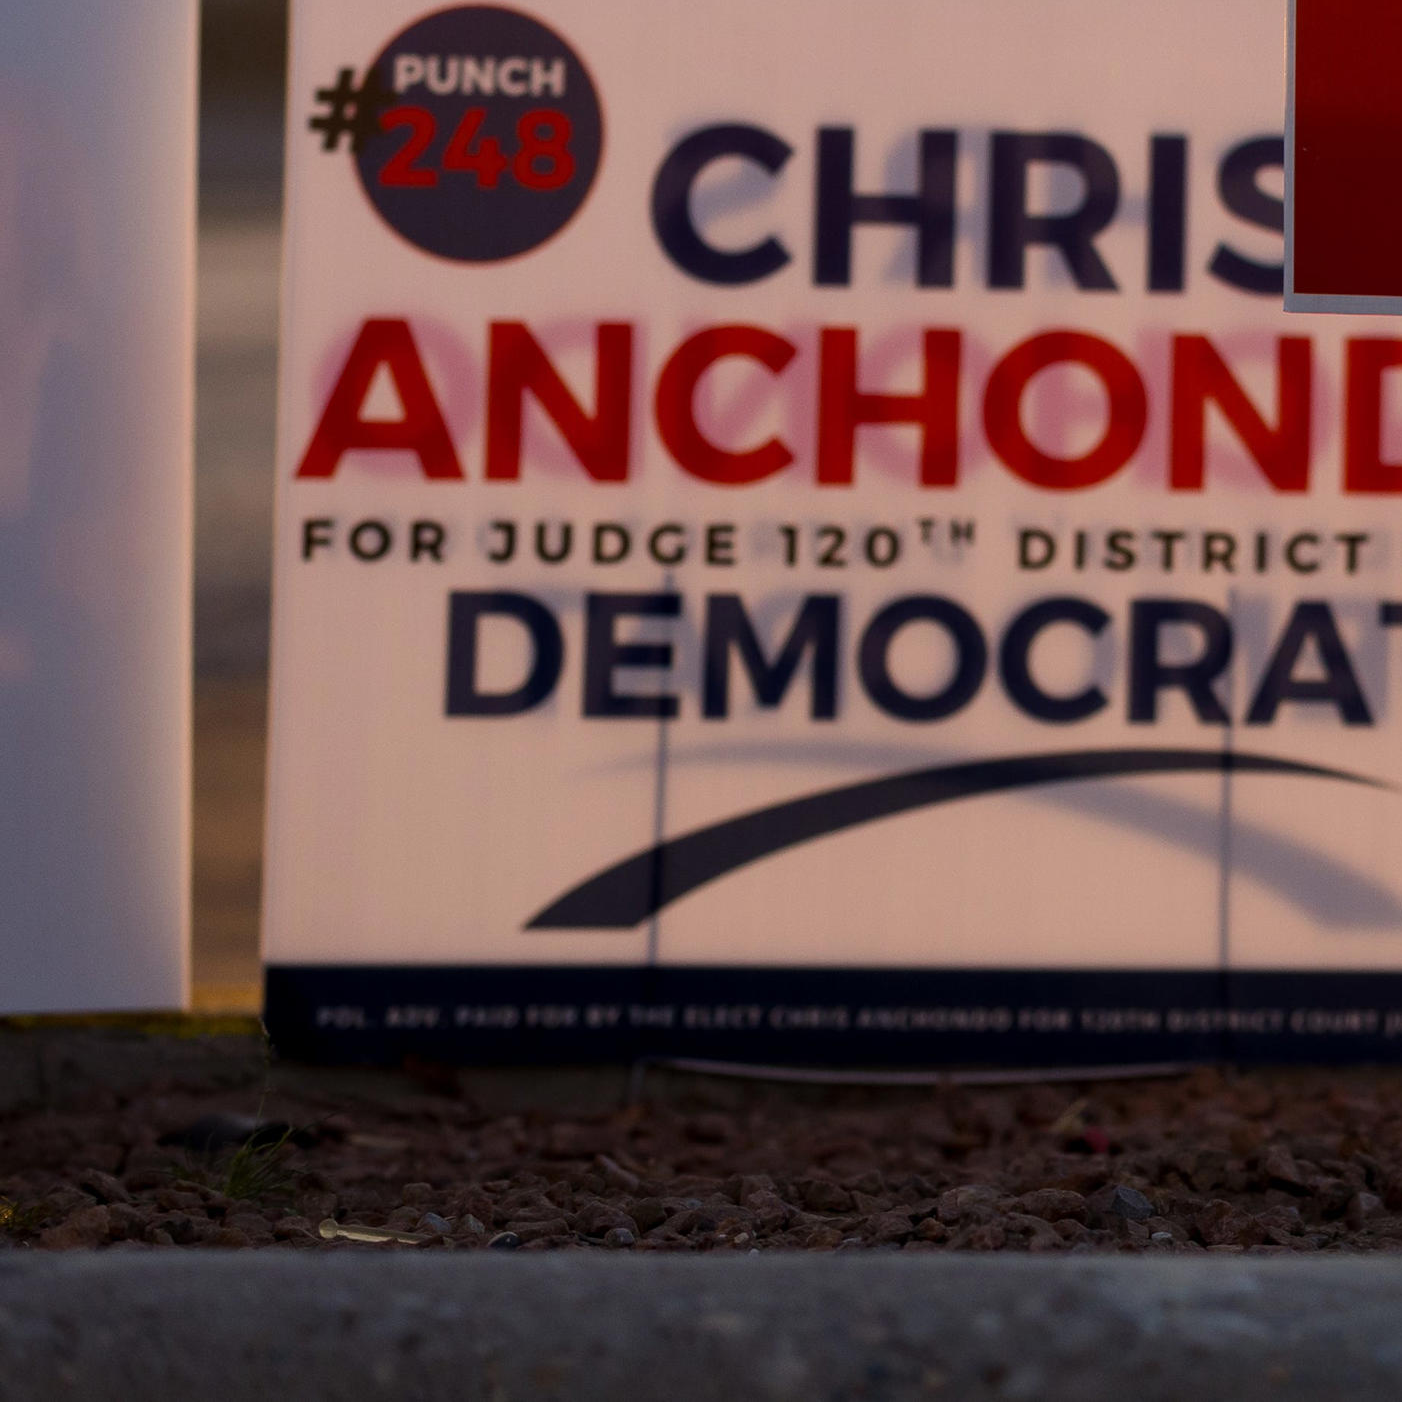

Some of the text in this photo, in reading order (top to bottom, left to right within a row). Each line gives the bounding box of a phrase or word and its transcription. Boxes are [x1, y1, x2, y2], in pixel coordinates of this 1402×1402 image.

[394, 55, 565, 96] PUNCH
[650, 123, 1285, 296] CHRIS
[300, 517, 448, 564] FOR
[490, 520, 738, 567] JUDGE
[780, 517, 976, 569] 120TH
[1017, 528, 1369, 575] DISTRICT
[455, 1005, 519, 1029] PAID
[525, 1005, 577, 1029] FOR
[585, 1005, 620, 1029] BY
[629, 1005, 674, 1029] THE
[684, 1005, 762, 1029] ELECT
[769, 1007, 850, 1032] CHRIS
[856, 1007, 1013, 1032] ANCHONDO
[1018, 1007, 1071, 1032] FOR
[1166, 1007, 1284, 1032] DISTRICT
[1290, 1009, 1378, 1035] COURT
